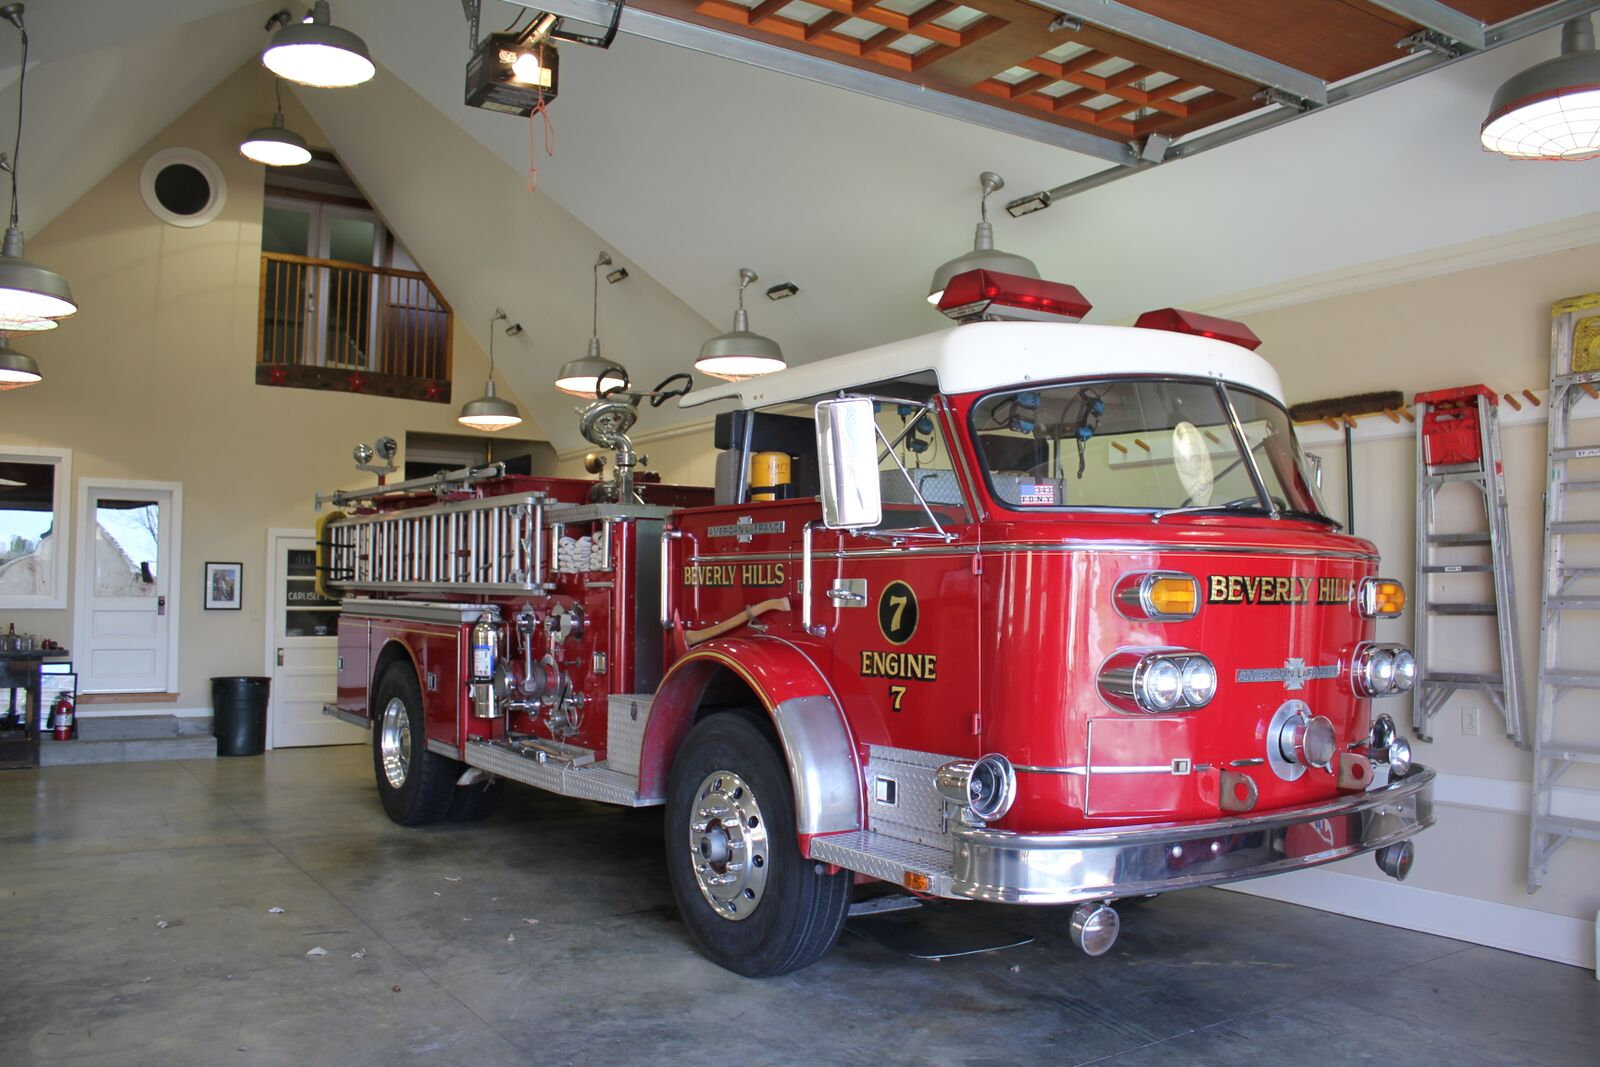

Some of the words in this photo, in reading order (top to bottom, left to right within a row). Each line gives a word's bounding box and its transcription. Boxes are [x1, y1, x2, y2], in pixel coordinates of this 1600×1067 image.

[683, 565, 737, 587] BEVERLY
[741, 563, 785, 586] HILLS
[1208, 575, 1312, 604] BEVERLY
[1317, 577, 1356, 604] HILLS
[890, 595, 907, 632] 7
[861, 651, 937, 680] ENGINE
[890, 685, 906, 711] 7
